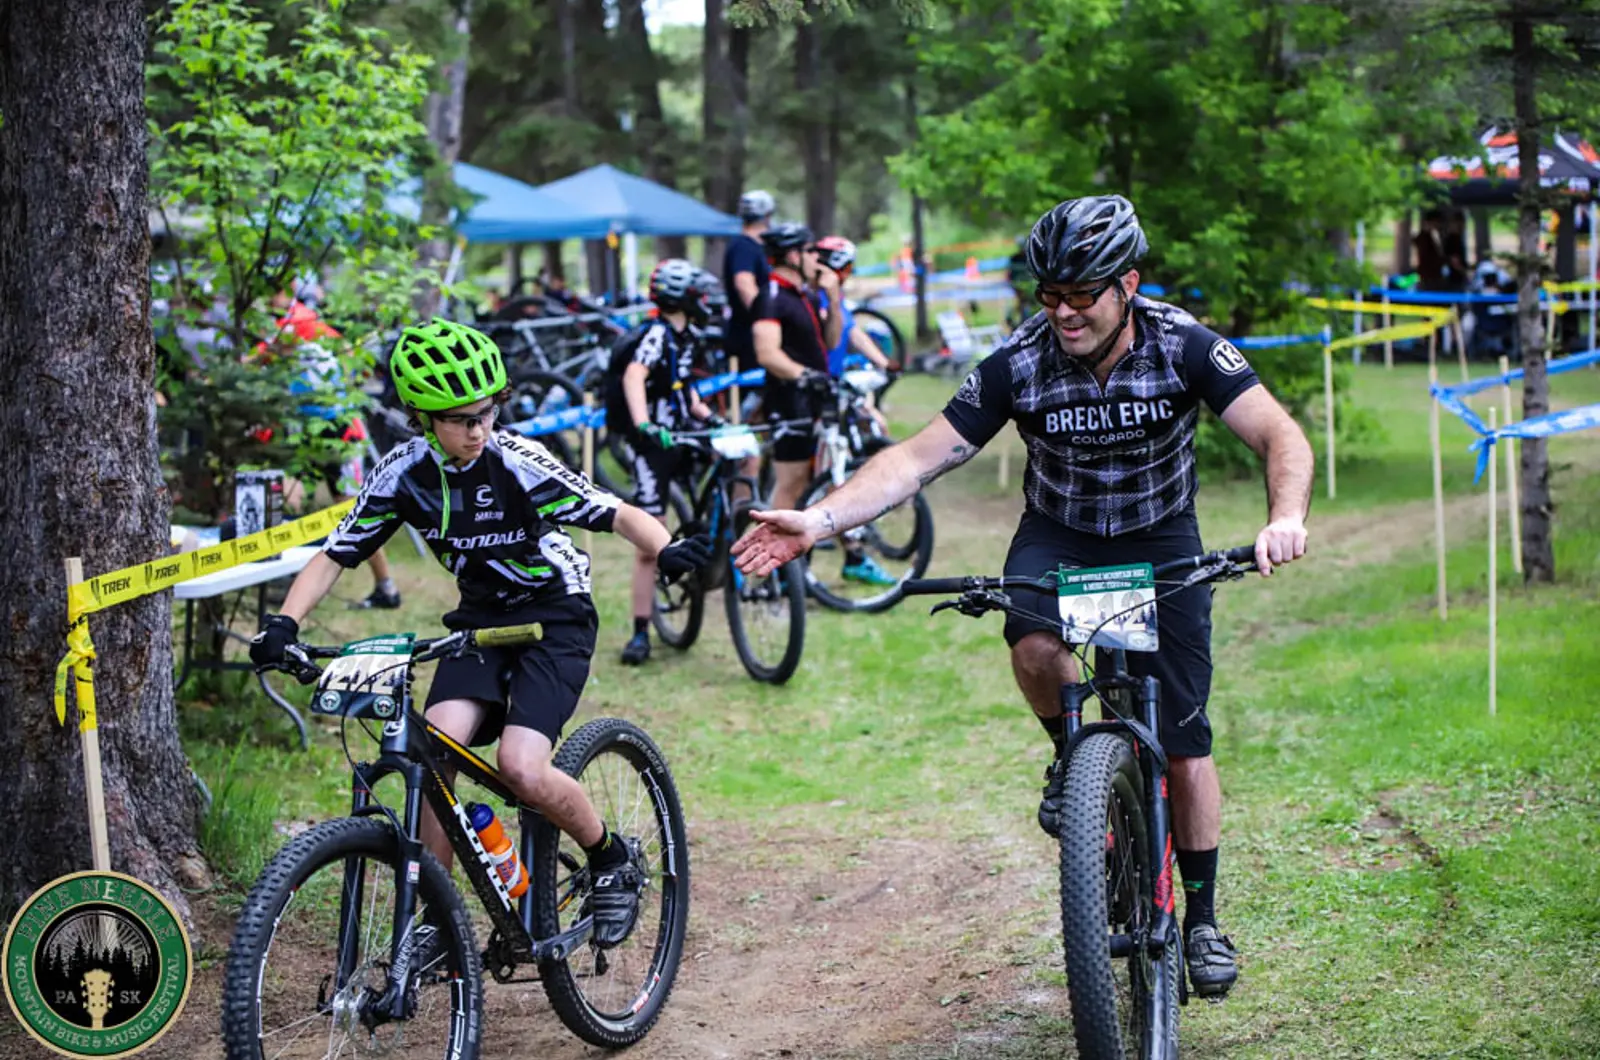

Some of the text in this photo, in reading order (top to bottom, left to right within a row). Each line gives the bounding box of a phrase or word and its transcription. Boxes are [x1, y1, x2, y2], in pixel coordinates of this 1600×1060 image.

[1215, 342, 1243, 369] 13
[1046, 399, 1174, 434] BRECK EPIC
[1071, 429, 1146, 446] COLORADO
[102, 576, 132, 596] TREK
[154, 562, 181, 581] TREK
[200, 551, 223, 568] TREK
[1072, 590, 1146, 631] 212
